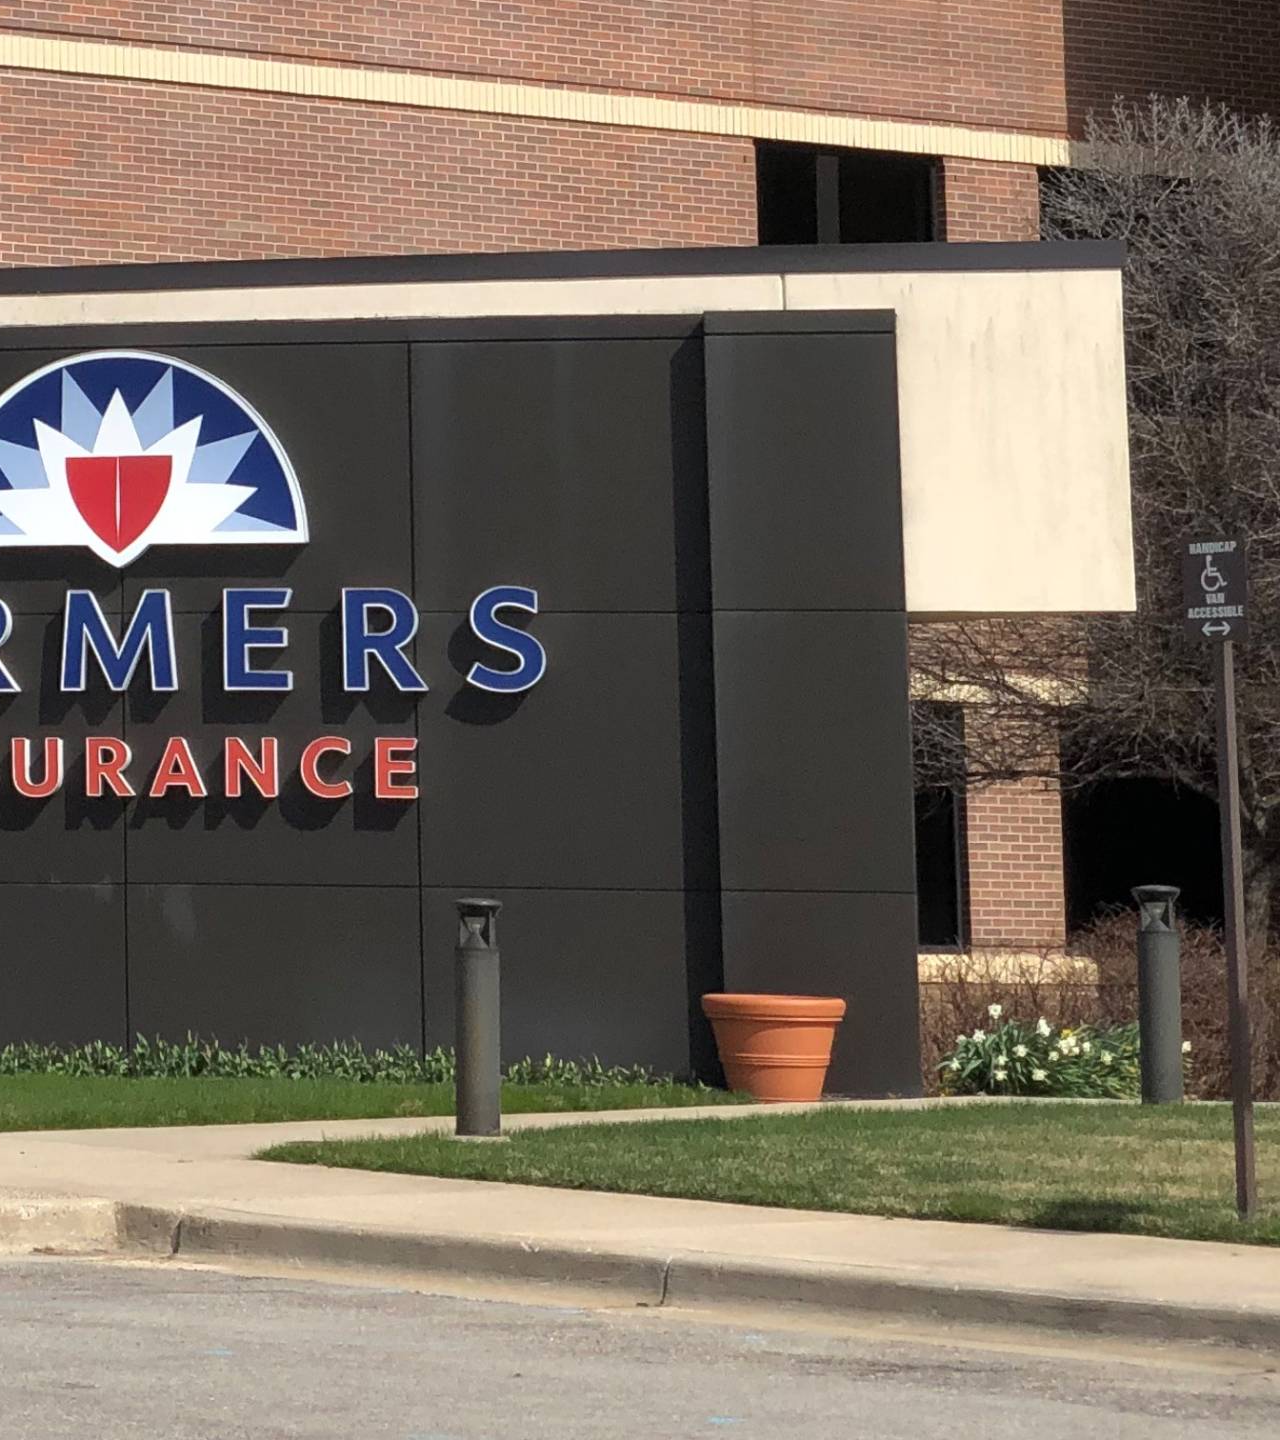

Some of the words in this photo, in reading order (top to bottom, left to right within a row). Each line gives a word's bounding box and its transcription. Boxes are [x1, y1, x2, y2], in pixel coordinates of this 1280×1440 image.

[1189, 541, 1237, 554] HANDICAP
[1206, 593, 1225, 604] VAN
[1188, 605, 1244, 619] ACCESSIBLE
